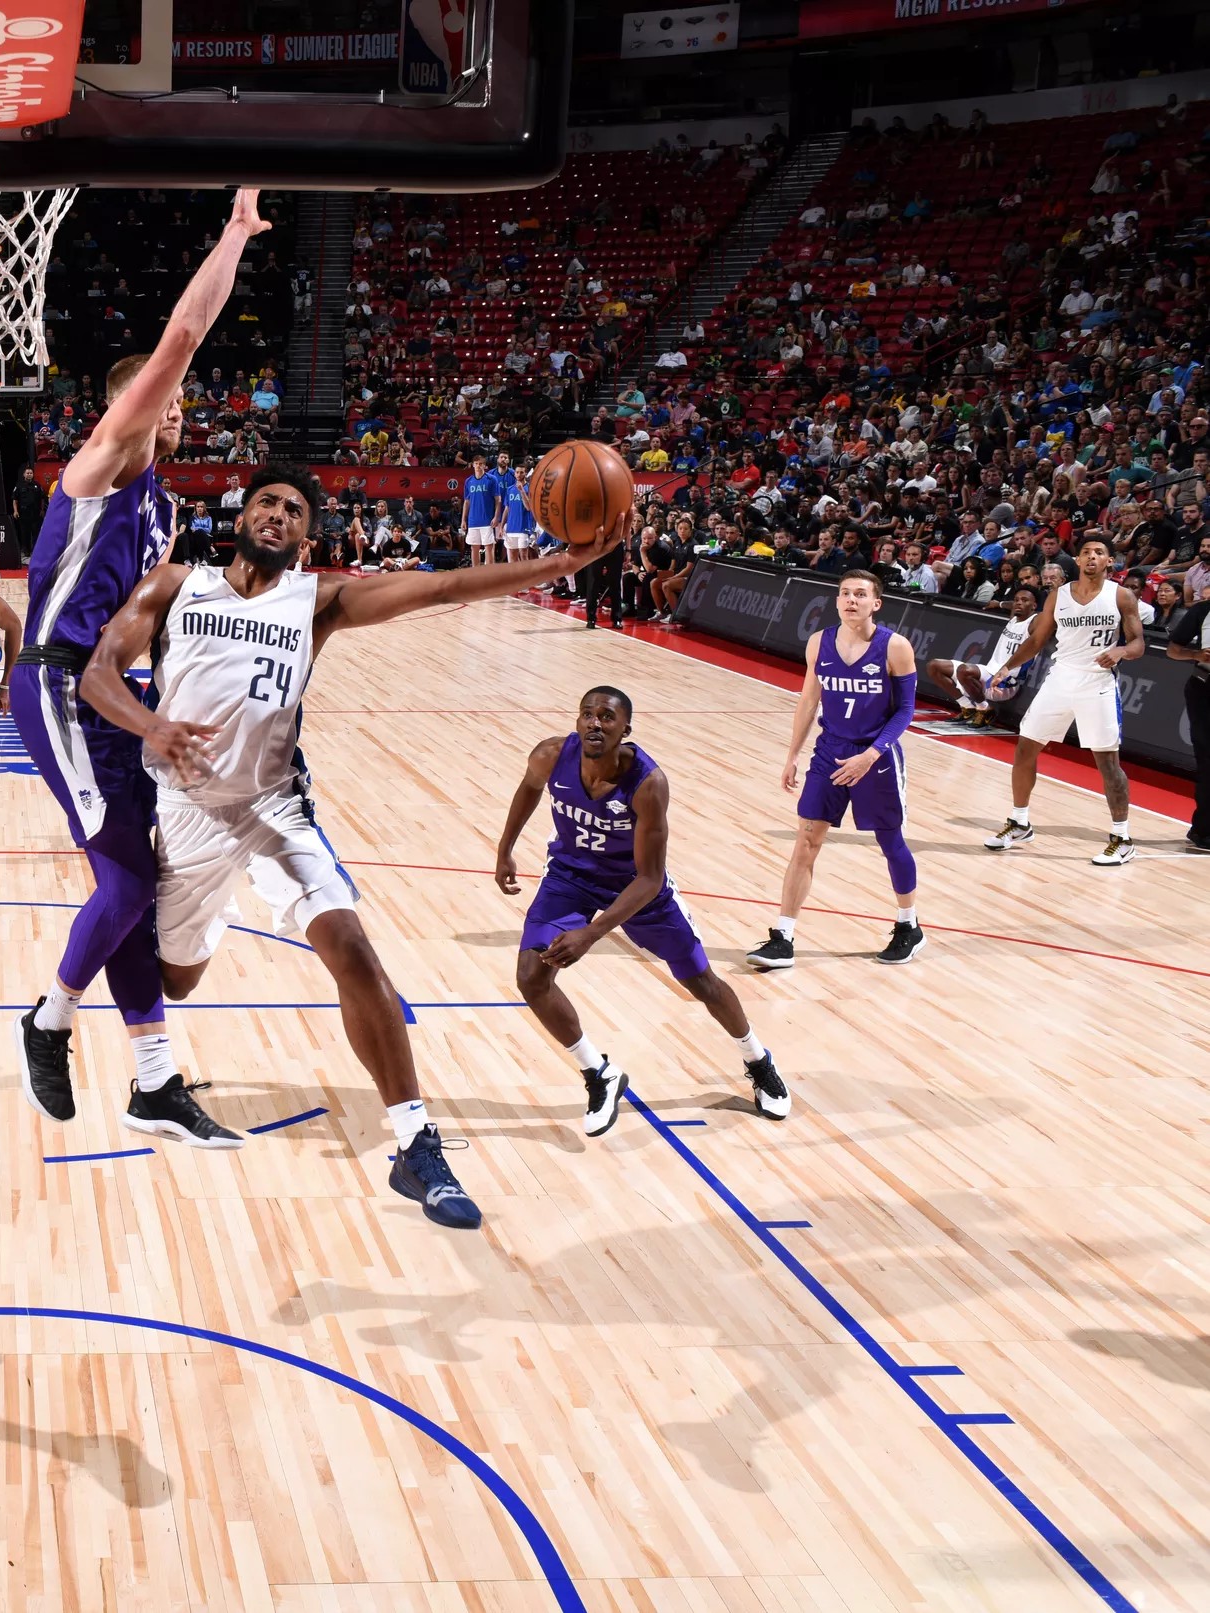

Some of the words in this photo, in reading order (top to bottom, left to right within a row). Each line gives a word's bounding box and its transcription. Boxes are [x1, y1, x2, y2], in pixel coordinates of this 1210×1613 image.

[80, 37, 96, 47] ngs
[189, 40, 253, 58] RESORTS
[284, 34, 345, 62] SUMMER
[348, 33, 399, 61] LEAGUE
[408, 61, 439, 88] NBA
[469, 483, 488, 493] DAL
[509, 492, 523, 501] DA
[715, 583, 791, 624] GATORADE
[182, 611, 302, 653] MAVERICKS
[1058, 614, 1116, 629] MAVERICKS
[1090, 628, 1116, 647] 20
[248, 656, 293, 709] 24
[817, 674, 883, 694] KINGS
[844, 697, 856, 719] 7
[550, 794, 633, 832] KINGS
[575, 826, 607, 851] 22
